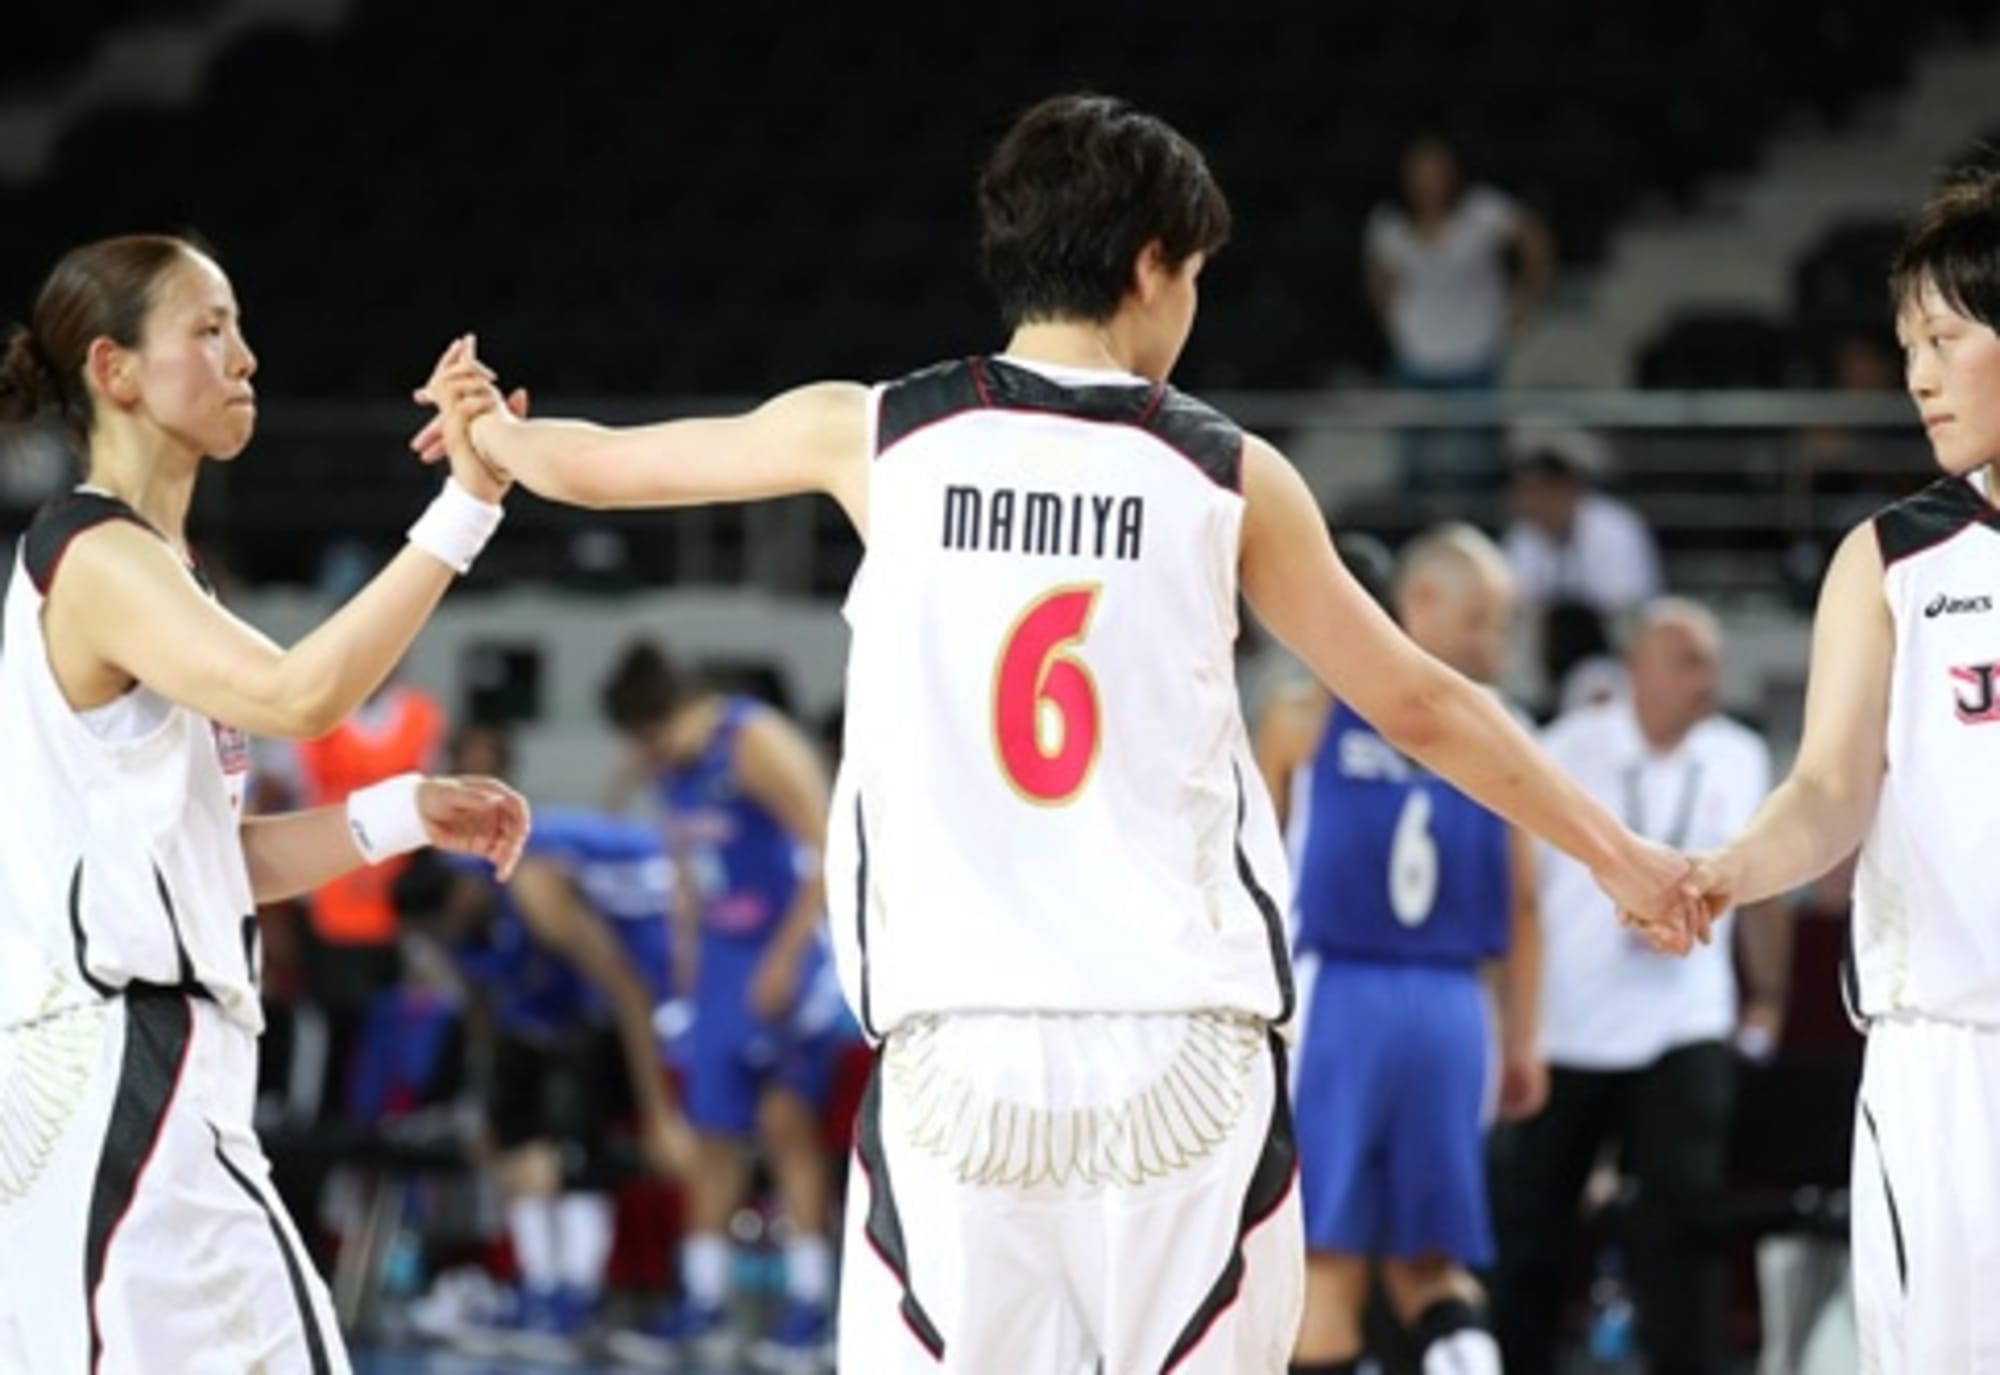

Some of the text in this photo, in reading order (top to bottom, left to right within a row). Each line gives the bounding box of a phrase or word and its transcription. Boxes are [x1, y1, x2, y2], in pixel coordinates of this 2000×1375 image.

[942, 485, 1144, 560] MAMIYA
[991, 581, 1102, 807] 6
[1389, 788, 1439, 927] 6
